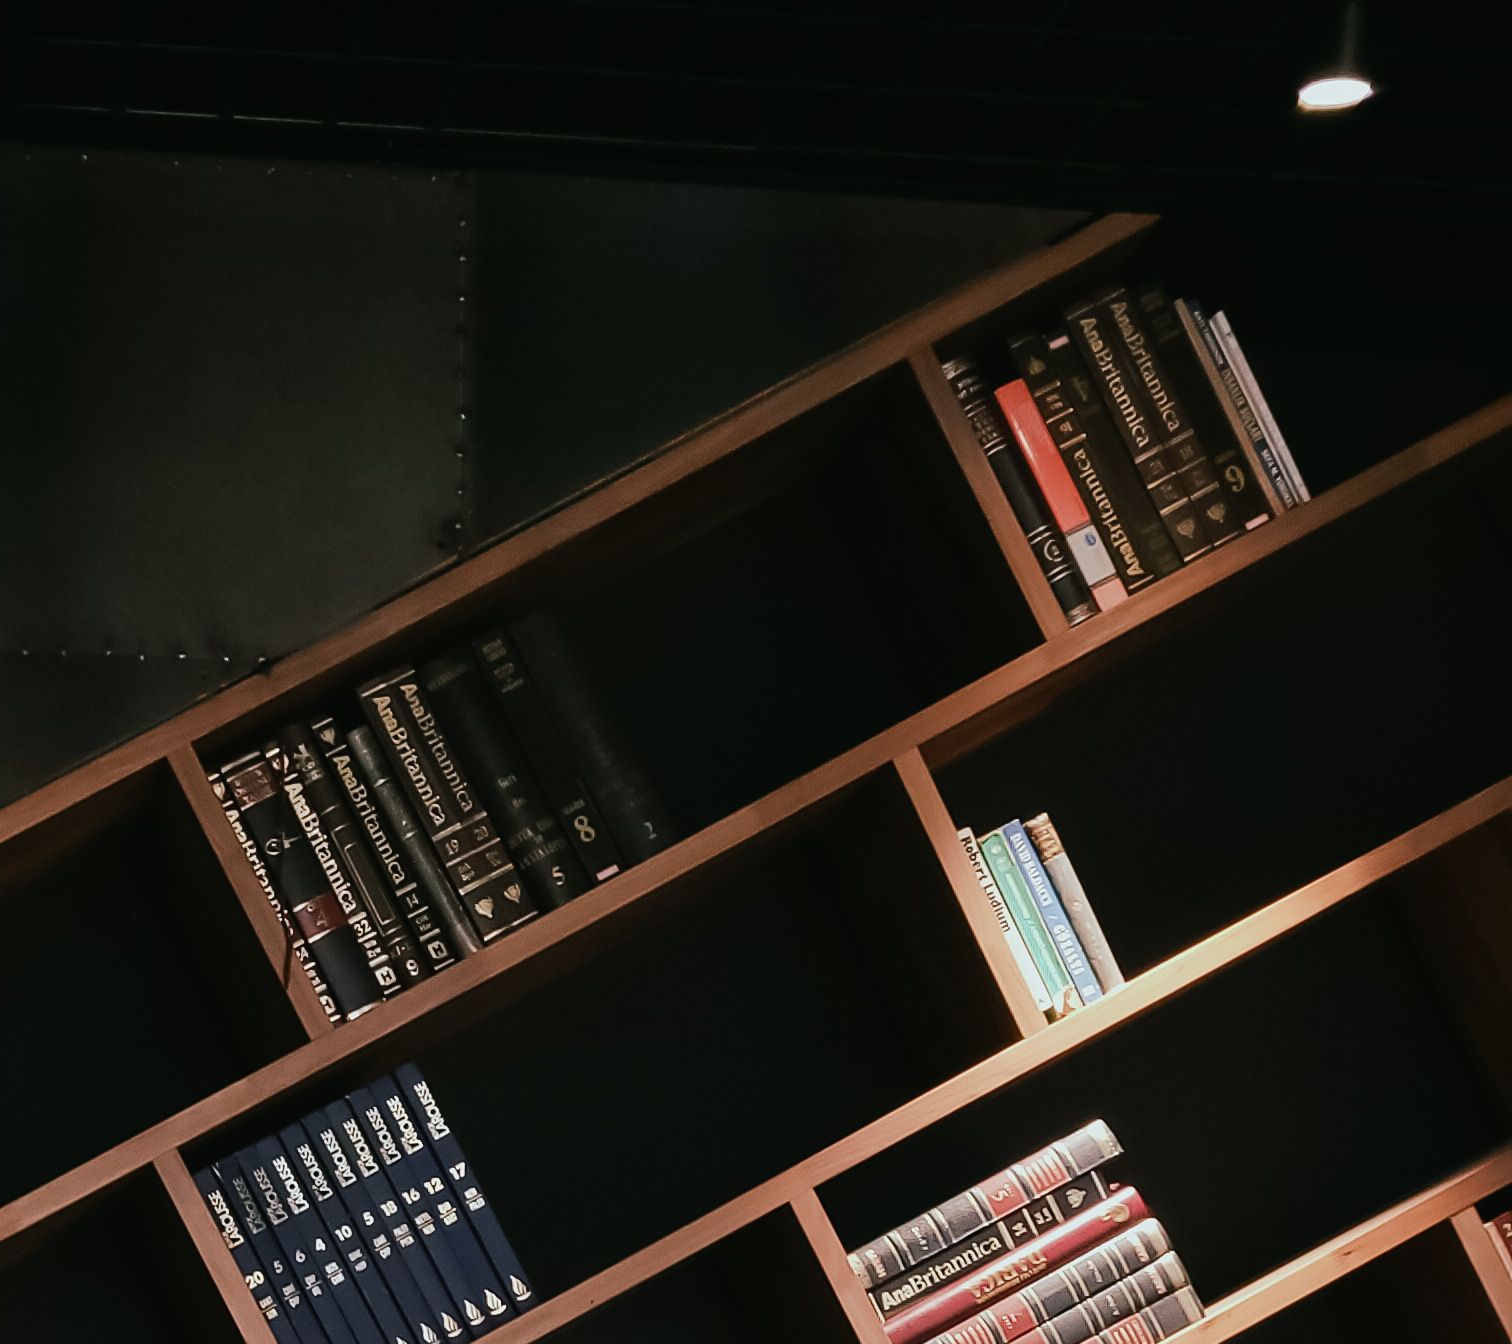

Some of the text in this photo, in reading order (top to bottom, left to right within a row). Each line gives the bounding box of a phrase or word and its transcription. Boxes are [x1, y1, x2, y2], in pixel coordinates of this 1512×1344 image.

[1078, 313, 1154, 448] AnaBritannica
[1109, 298, 1184, 433] AnaBritannica
[1069, 447, 1144, 579] AnaBritannica
[371, 691, 450, 827] AnaBritannica
[398, 679, 477, 813] AnaBritannica
[282, 779, 362, 915] AnaBritannica
[331, 751, 409, 886] AnaBritannica
[570, 812, 599, 845] 8
[352, 918, 372, 936] 32
[364, 1105, 402, 1165] LAROUSSE
[384, 1094, 424, 1155] LAROUSSE
[412, 1079, 451, 1140] LAROUSSE
[296, 1142, 334, 1202] LAROUSSE
[318, 1127, 357, 1188] LAROUSSE
[341, 1117, 379, 1178] LAROUSSE
[447, 1160, 471, 1182] 17
[251, 1165, 289, 1225] LAROUSSE
[271, 1154, 310, 1215] LAROUSSE
[400, 1185, 423, 1206] 16
[422, 1174, 445, 1196] 12
[207, 1188, 245, 1248] LAROUSSE
[311, 1236, 328, 1254] 4
[333, 1222, 355, 1243] 10
[360, 1209, 376, 1227] 5
[1010, 1220, 1028, 1237] 14
[243, 1268, 267, 1290] 20
[270, 1258, 285, 1276] 5
[291, 1247, 308, 1265] 6
[876, 1229, 1003, 1311] AnaBritannica
